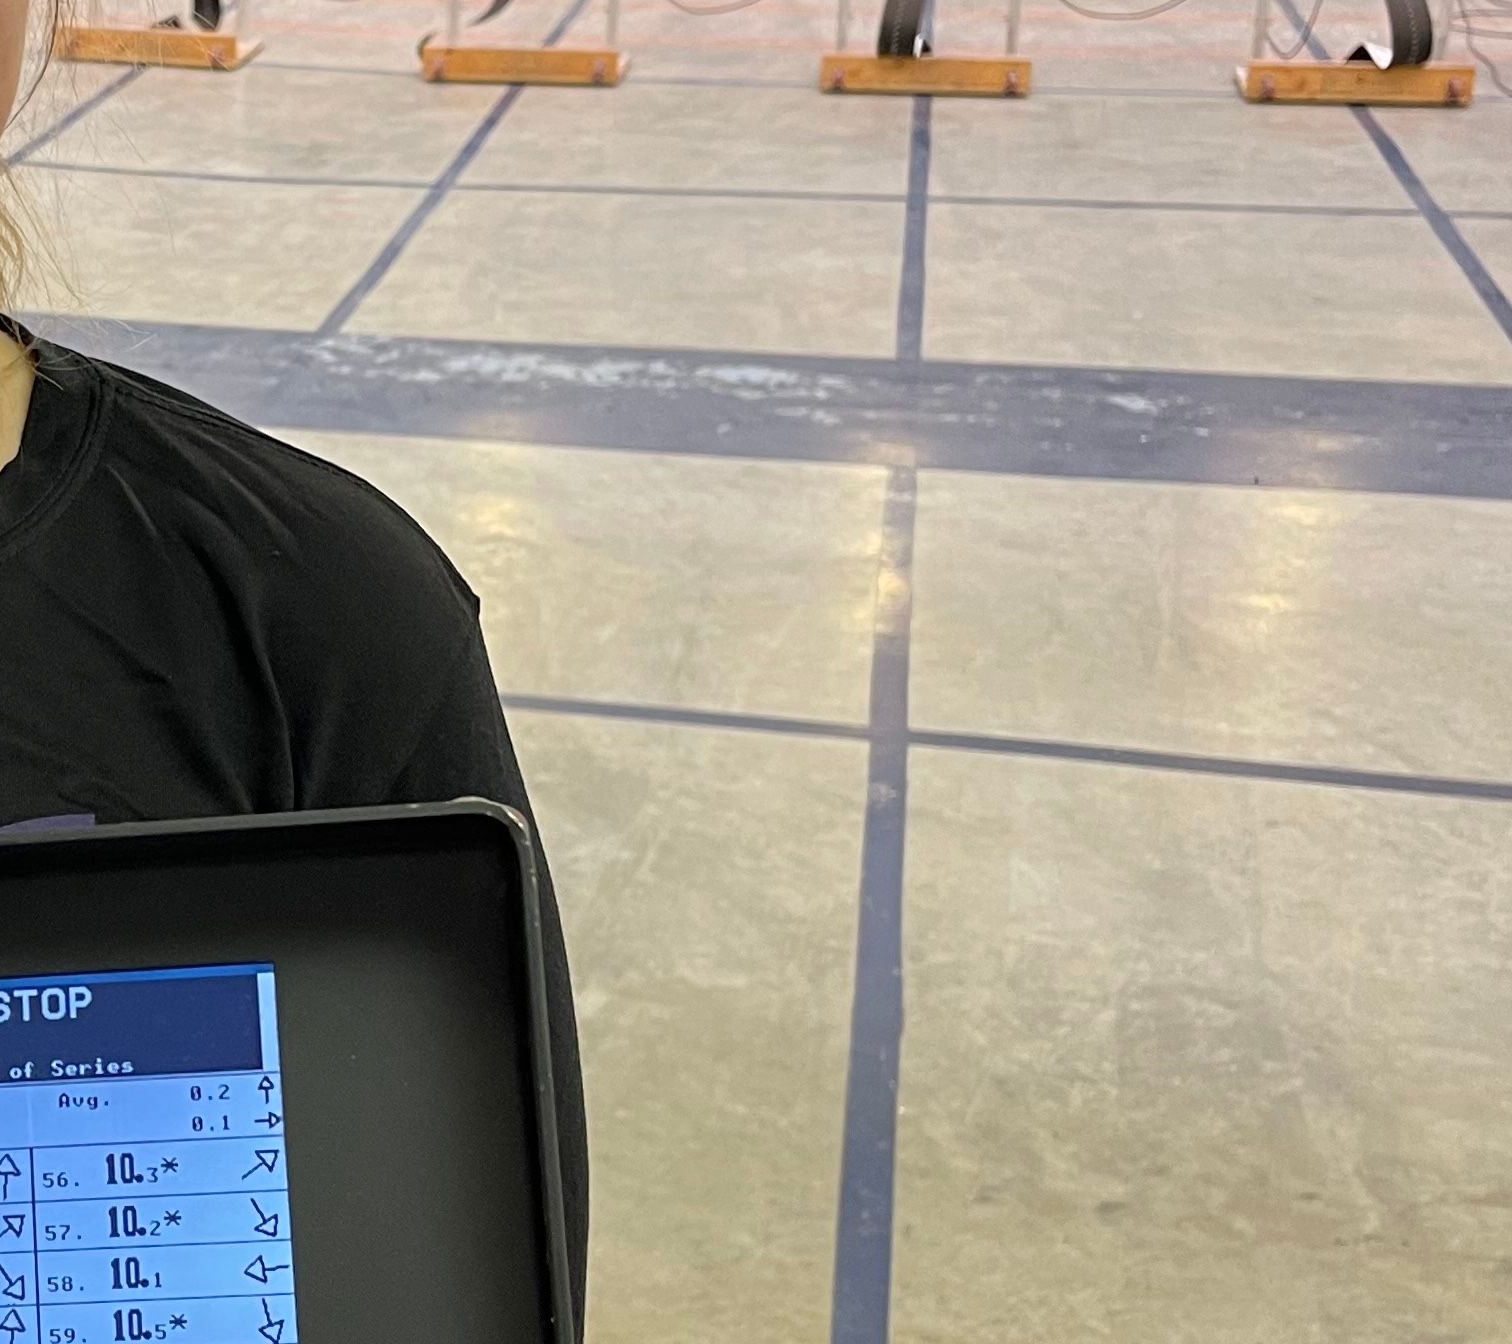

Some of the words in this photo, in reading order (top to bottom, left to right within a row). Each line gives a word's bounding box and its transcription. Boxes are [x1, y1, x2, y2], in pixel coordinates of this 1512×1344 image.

[9, 1061, 34, 1079] of
[50, 1057, 134, 1077] Series
[58, 1092, 109, 1111] Avg.
[190, 1084, 230, 1101] 0.2
[192, 1115, 230, 1132] 0.1
[42, 1171, 80, 1189] 56.
[44, 1224, 82, 1242] 57.
[47, 1276, 84, 1293] 58.
[110, 1256, 162, 1290] 10.1
[49, 1328, 87, 1344] 59.
